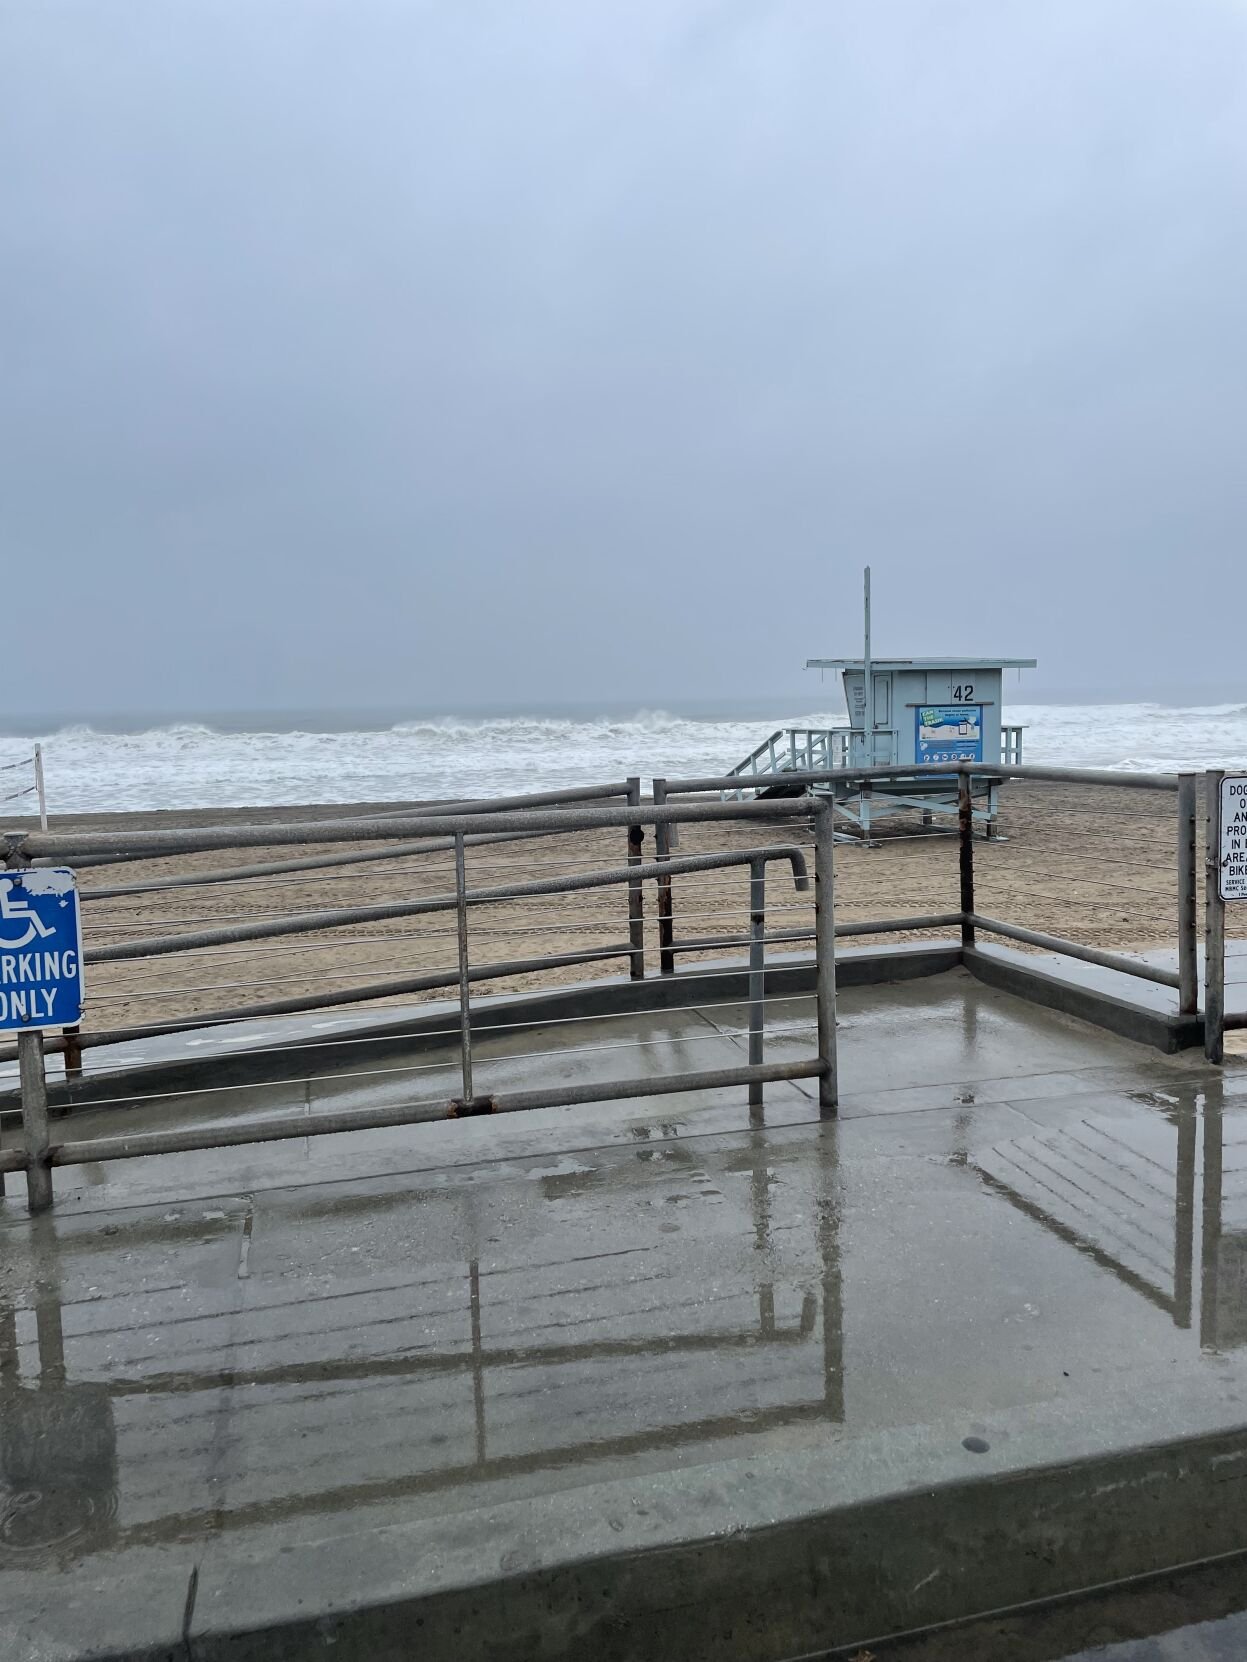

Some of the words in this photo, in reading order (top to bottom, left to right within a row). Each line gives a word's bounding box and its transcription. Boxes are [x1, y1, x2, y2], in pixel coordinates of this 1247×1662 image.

[953, 685, 974, 701] 42
[1231, 838, 1241, 849] IN
[1226, 852, 1247, 863] ARE
[0, 950, 77, 985] RKING
